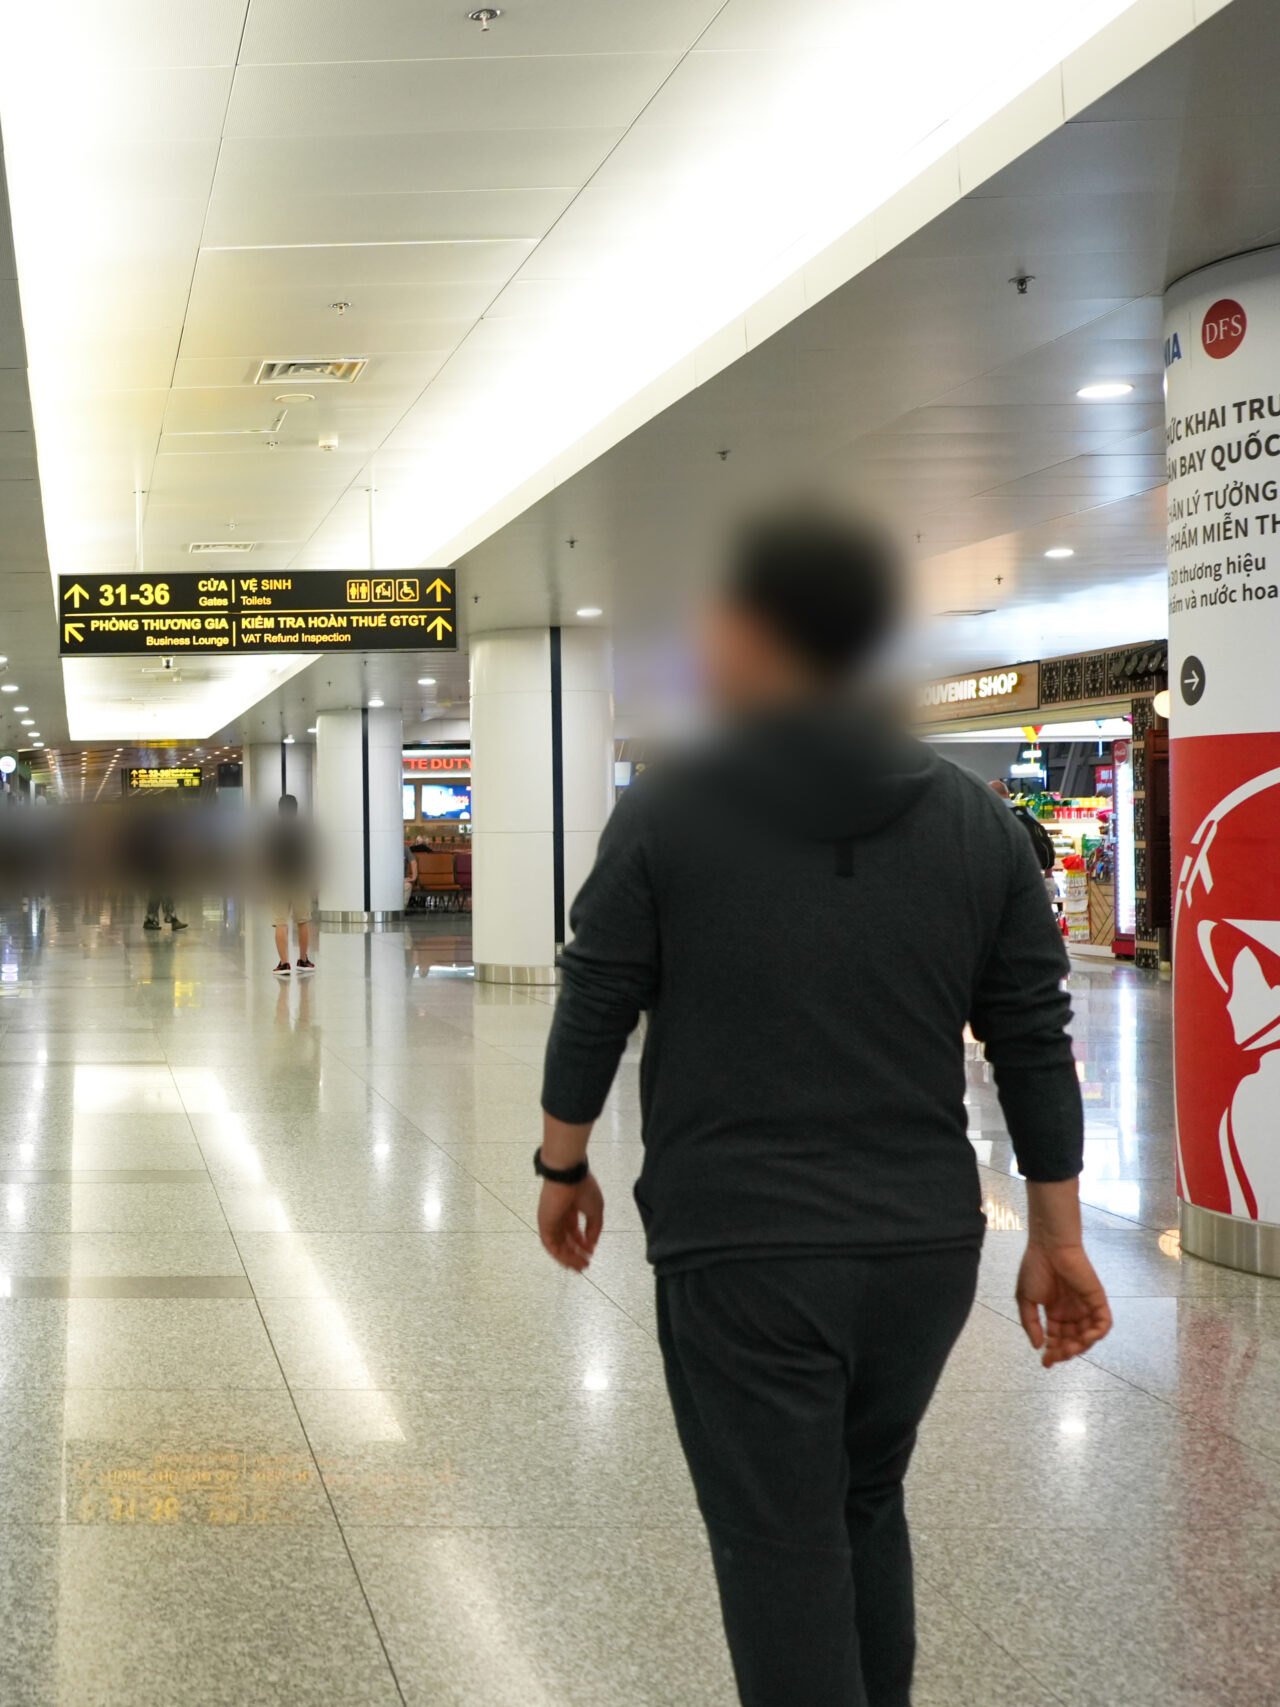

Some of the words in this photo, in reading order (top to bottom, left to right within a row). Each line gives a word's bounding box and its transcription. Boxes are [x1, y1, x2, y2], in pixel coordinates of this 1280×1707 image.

[1205, 314, 1243, 344] DFS
[1185, 405, 1227, 438] KHAI
[1180, 448, 1206, 477] BAY
[1211, 430, 1280, 471] QUỐC
[1186, 489, 1201, 517] LÝ
[1204, 480, 1278, 512] TƯỞNG
[1202, 512, 1248, 545] MIỄN
[1179, 563, 1222, 584] thương
[1226, 552, 1266, 577] hiệu
[198, 578, 228, 591] CỬA
[240, 578, 258, 593] VỆ
[261, 579, 292, 590] SINH
[99, 583, 170, 606] 31-36
[199, 596, 229, 606] Gates
[240, 596, 272, 605] Toilets
[1185, 589, 1197, 610] và
[1200, 584, 1237, 607] nước
[1242, 583, 1278, 602] hoa
[90, 617, 139, 631] PHÒNG
[142, 618, 202, 631] THƯƠNG
[204, 617, 229, 629] GIA
[277, 617, 306, 628] TRA
[308, 613, 347, 628] HOÀN
[389, 615, 427, 627] GTGT
[146, 635, 190, 646] Business
[193, 634, 229, 646] Lounge
[241, 634, 261, 643] VAT
[263, 633, 299, 643] Refund
[301, 632, 351, 645] Inspection
[918, 679, 977, 706] OUVENIR
[978, 672, 1018, 698] SHOP
[403, 759, 428, 770] TE
